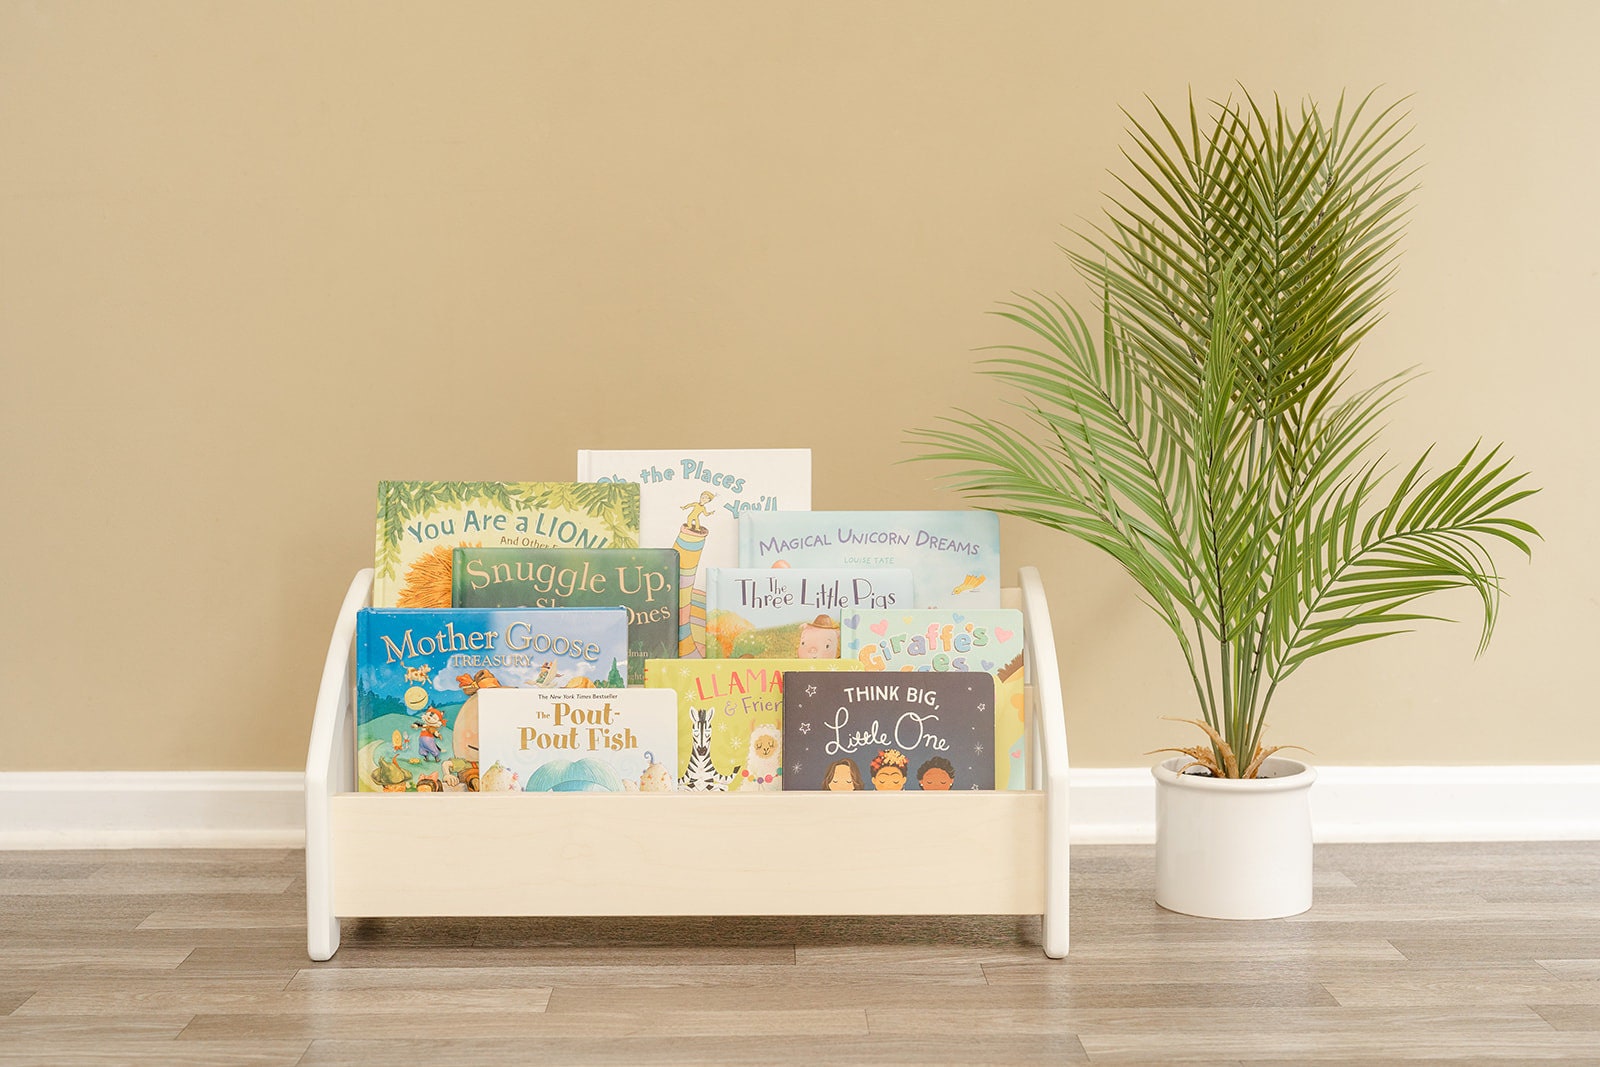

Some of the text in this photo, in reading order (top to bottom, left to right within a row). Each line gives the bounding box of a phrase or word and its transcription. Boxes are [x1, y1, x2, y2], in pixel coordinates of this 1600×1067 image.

[640, 465, 675, 484] the
[680, 459, 746, 493] Places
[407, 517, 455, 544] You
[463, 510, 507, 533] Are
[515, 516, 529, 533] a
[500, 536, 519, 545] And
[466, 559, 672, 602] Snuggle Up,
[734, 578, 794, 609] Three
[801, 578, 849, 609] Little
[766, 576, 788, 594] The
[380, 621, 600, 664] Mother Goose
[858, 623, 989, 672] Giraffe's
[451, 655, 534, 668] TREASURY
[724, 700, 738, 716] &
[844, 685, 940, 710] THINK BIG,
[536, 702, 620, 726] The Pout-
[517, 726, 639, 752] Pout Fish
[824, 707, 950, 755] Little One
